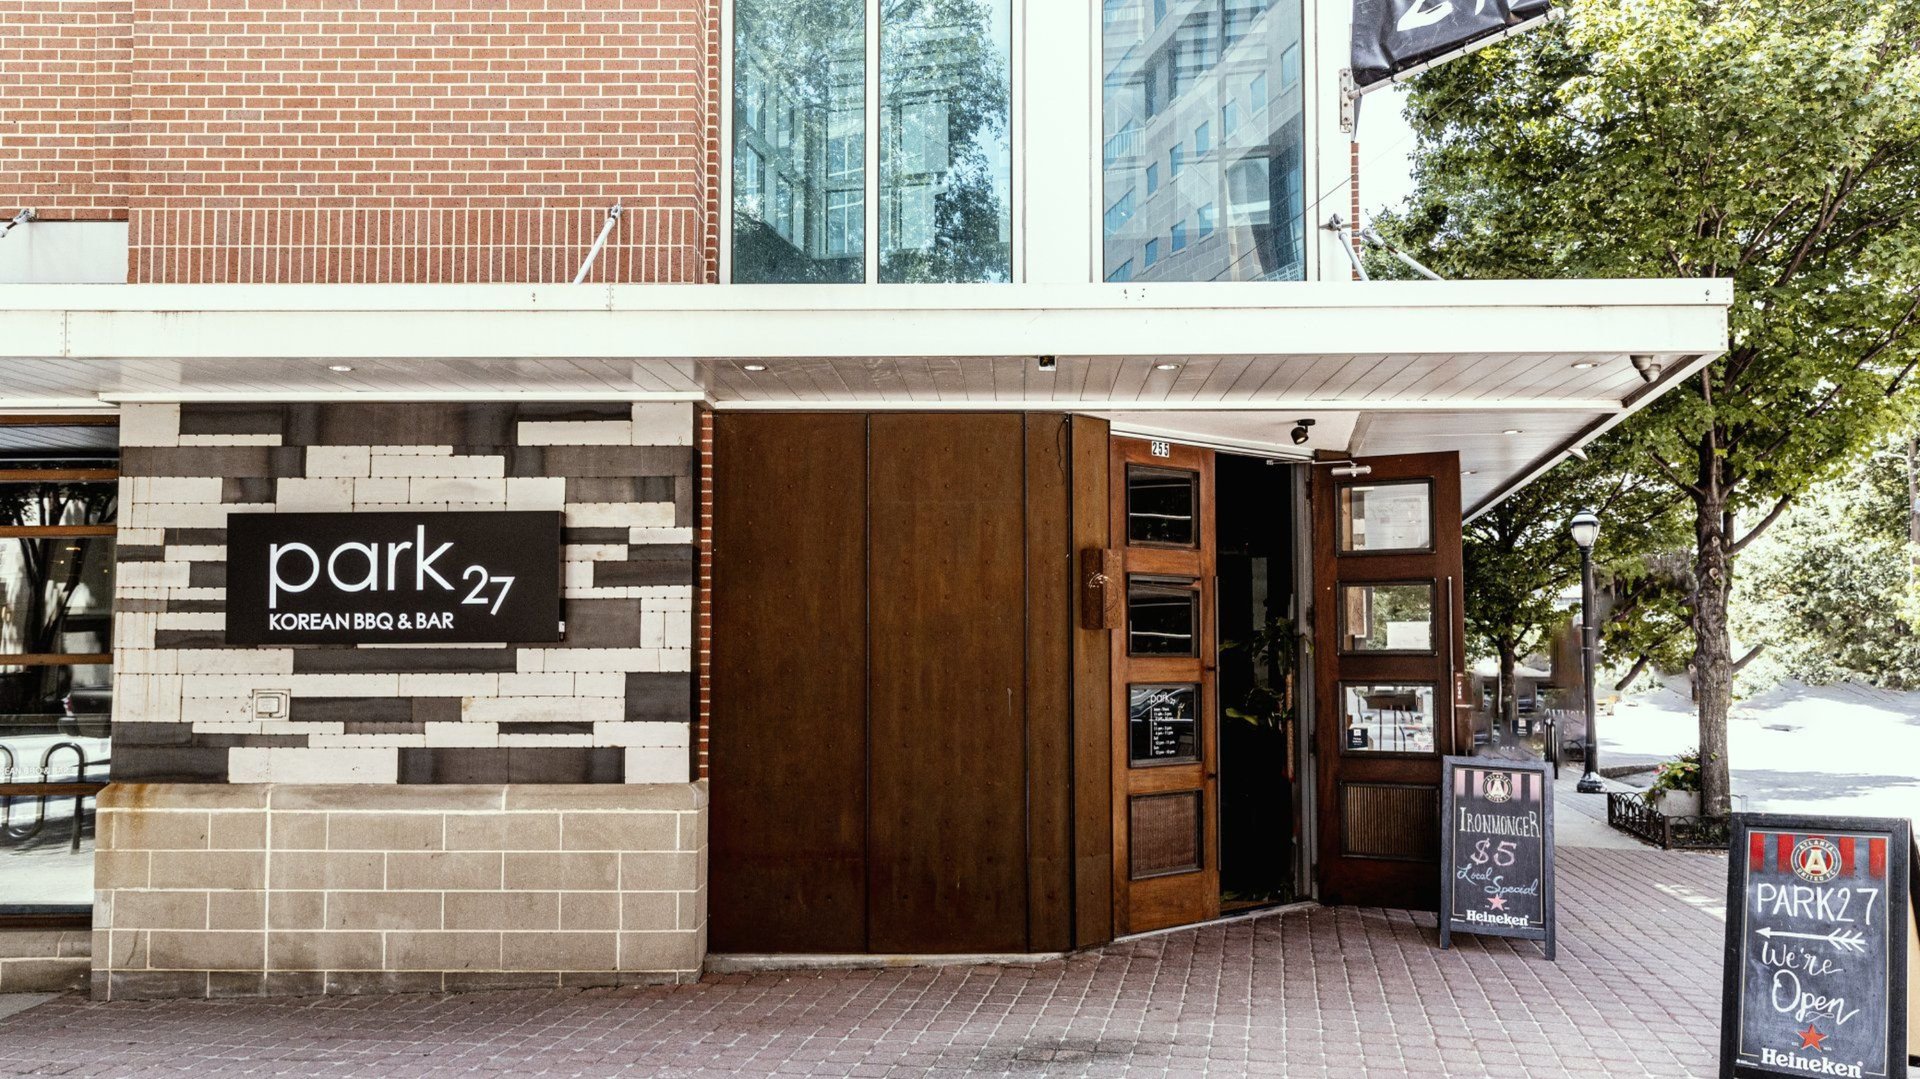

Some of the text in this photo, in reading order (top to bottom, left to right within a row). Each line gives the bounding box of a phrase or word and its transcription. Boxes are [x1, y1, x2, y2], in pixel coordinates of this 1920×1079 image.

[1152, 442, 1169, 457] 255
[268, 524, 516, 616] park 27
[268, 613, 454, 631] KOREAN BBQ & BAR
[1470, 838, 1517, 866] $5
[1799, 840, 1834, 852] ATLANTA
[1457, 863, 1492, 885] Local
[1484, 876, 1538, 897] Special
[1466, 910, 1529, 928] Heineken
[1762, 941, 1846, 976] We're
[1772, 969, 1859, 1025] Open
[1761, 1048, 1863, 1078] Heineken
